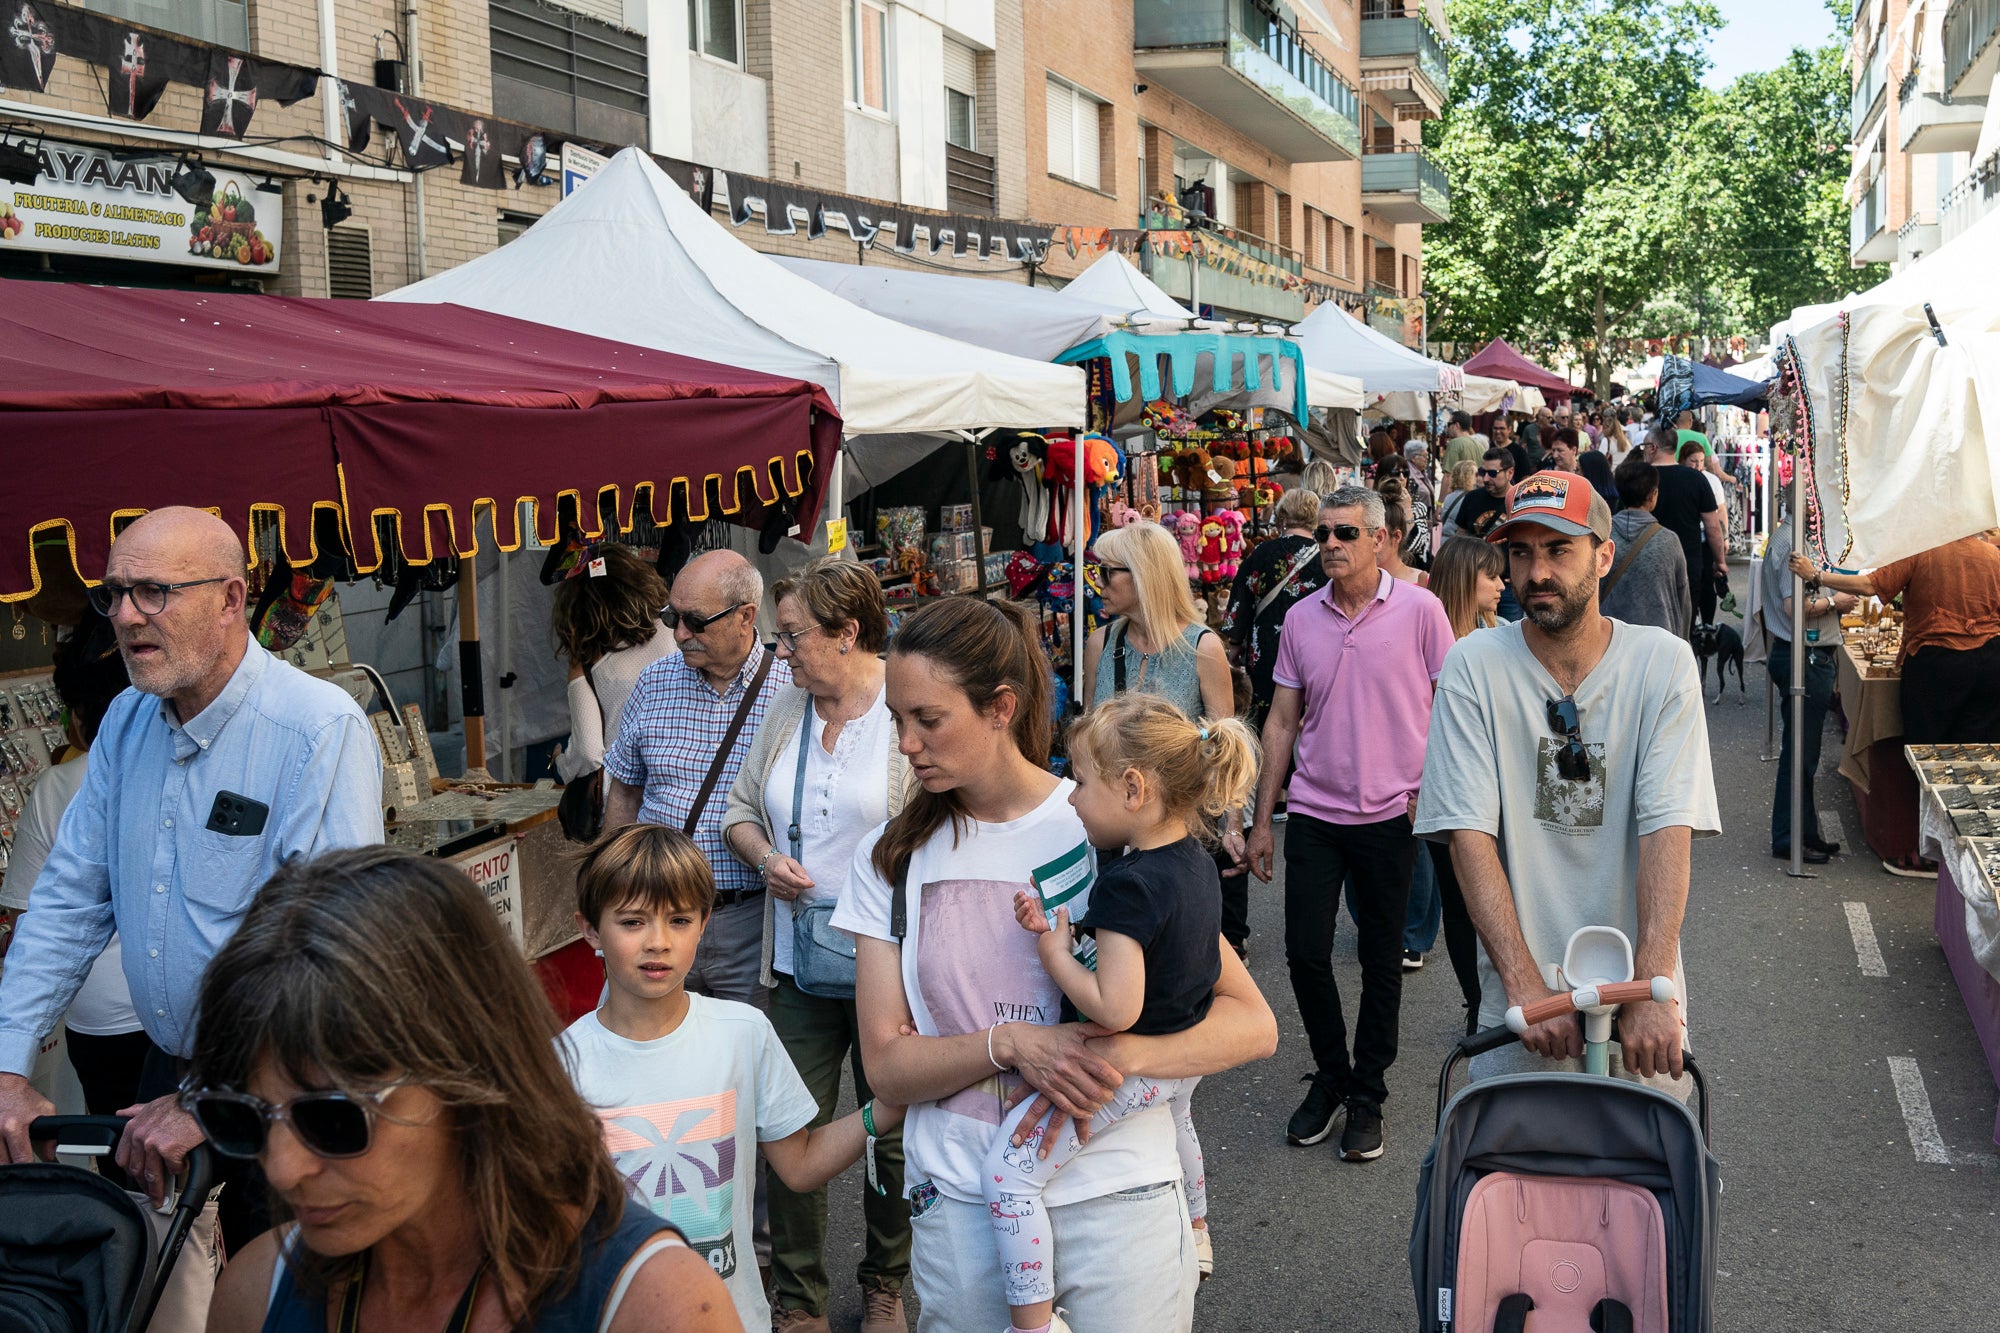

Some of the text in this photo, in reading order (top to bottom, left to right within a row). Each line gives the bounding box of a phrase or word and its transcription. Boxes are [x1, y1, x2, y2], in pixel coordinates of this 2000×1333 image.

[14, 191, 186, 228] FRUITERIA & ALIMENTACIO
[34, 222, 161, 250] PRODUCTES LLATINS
[493, 897, 512, 916] EN
[993, 1001, 1047, 1023] WHEN
